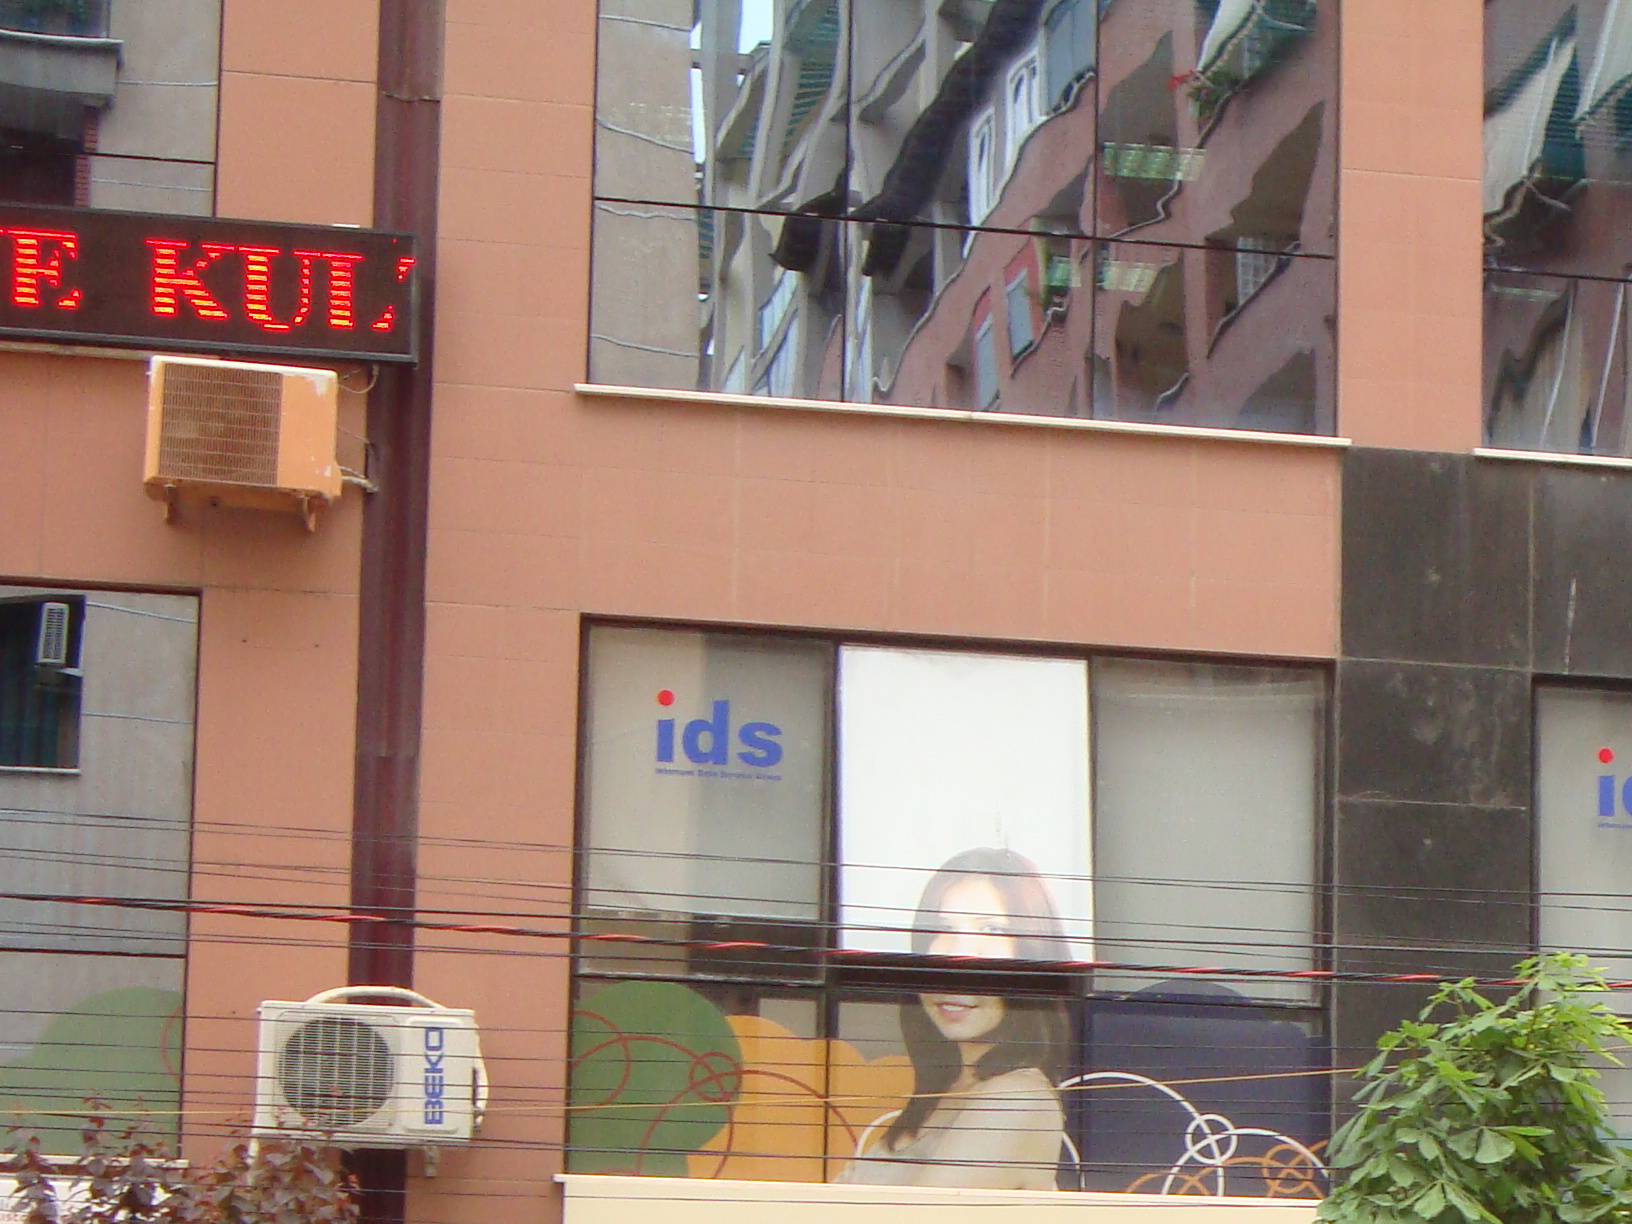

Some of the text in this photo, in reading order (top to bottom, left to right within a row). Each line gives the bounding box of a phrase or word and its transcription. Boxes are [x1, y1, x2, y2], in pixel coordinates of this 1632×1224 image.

[0, 228, 416, 331] E KUL
[656, 689, 783, 768] ids
[424, 1026, 444, 1125] BEKO
